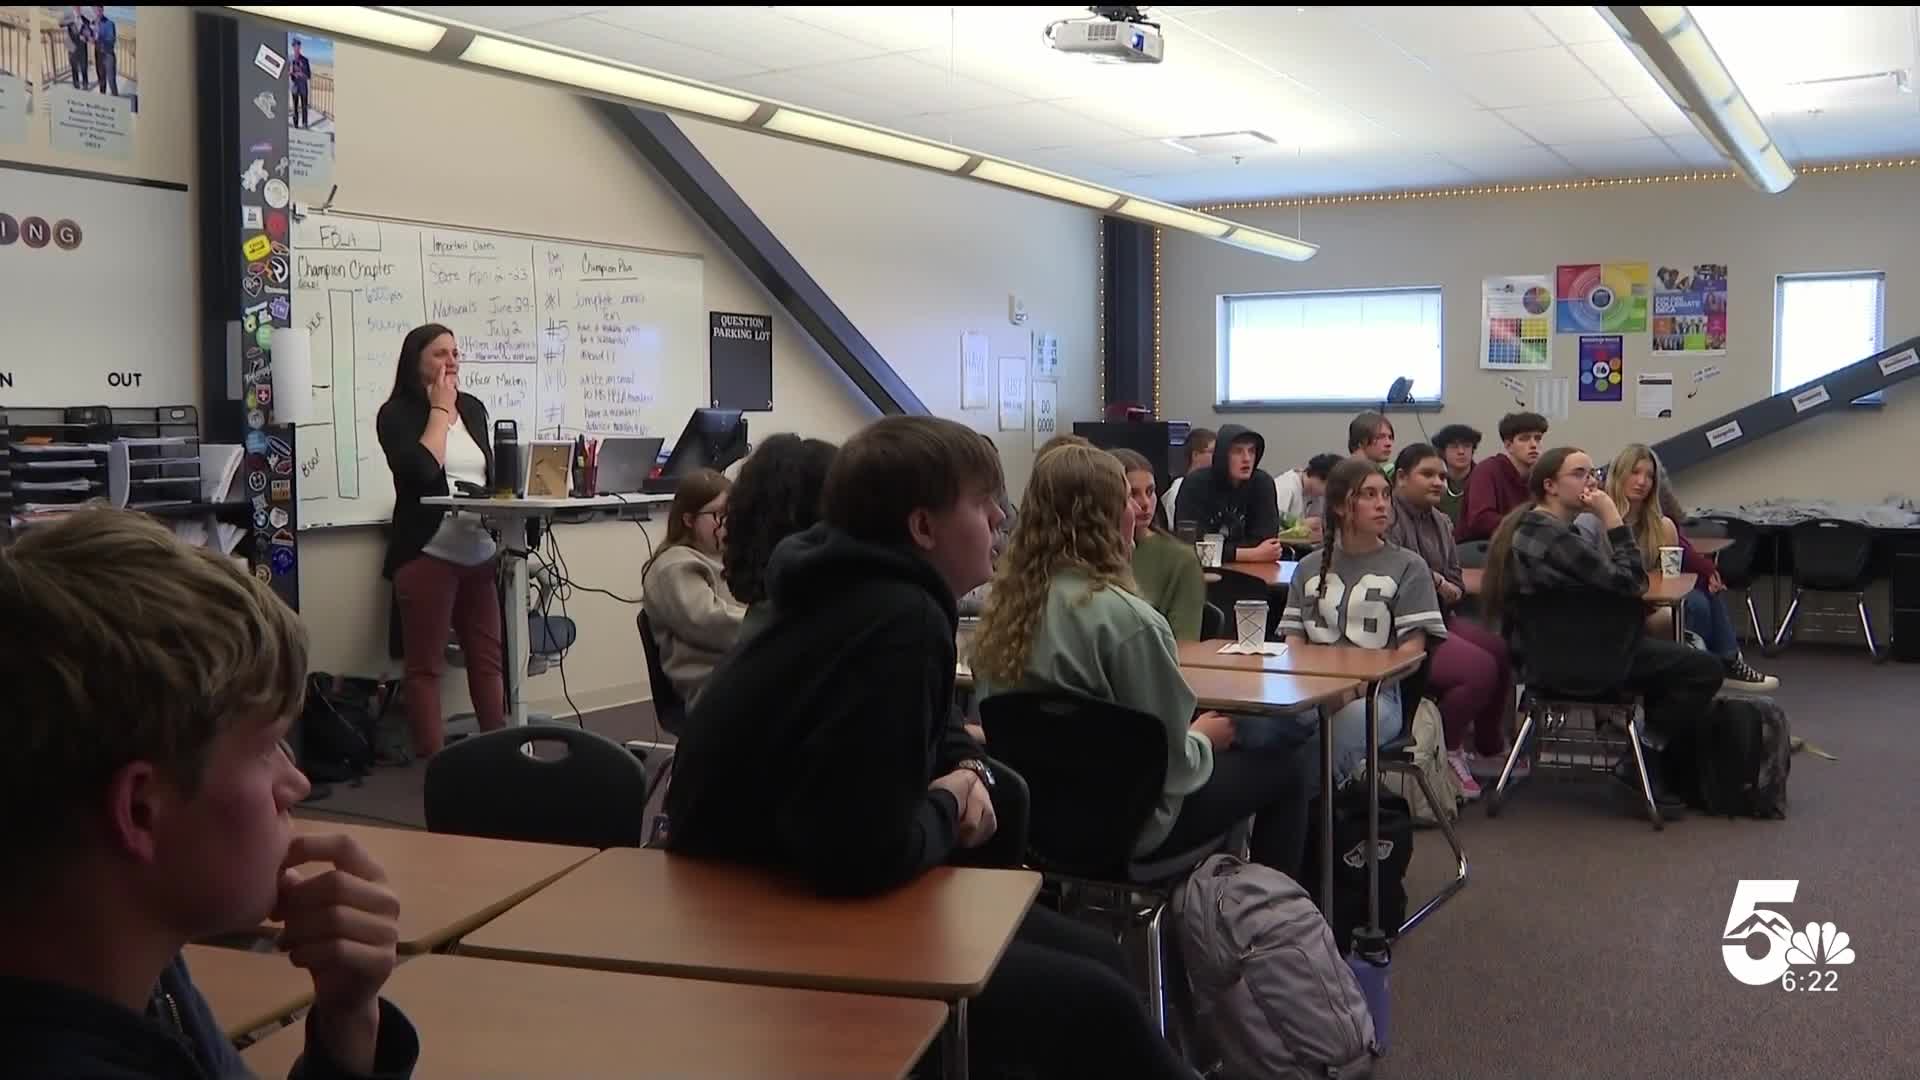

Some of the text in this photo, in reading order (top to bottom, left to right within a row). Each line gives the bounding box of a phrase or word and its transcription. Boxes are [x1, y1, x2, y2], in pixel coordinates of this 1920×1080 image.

[298, 255, 397, 281] Champion Chapter
[720, 314, 765, 329] QUESTION
[713, 326, 771, 341] PARKING LOT
[107, 372, 142, 387] OUT
[1037, 418, 1055, 433] GOOD
[1304, 573, 1398, 649] 36
